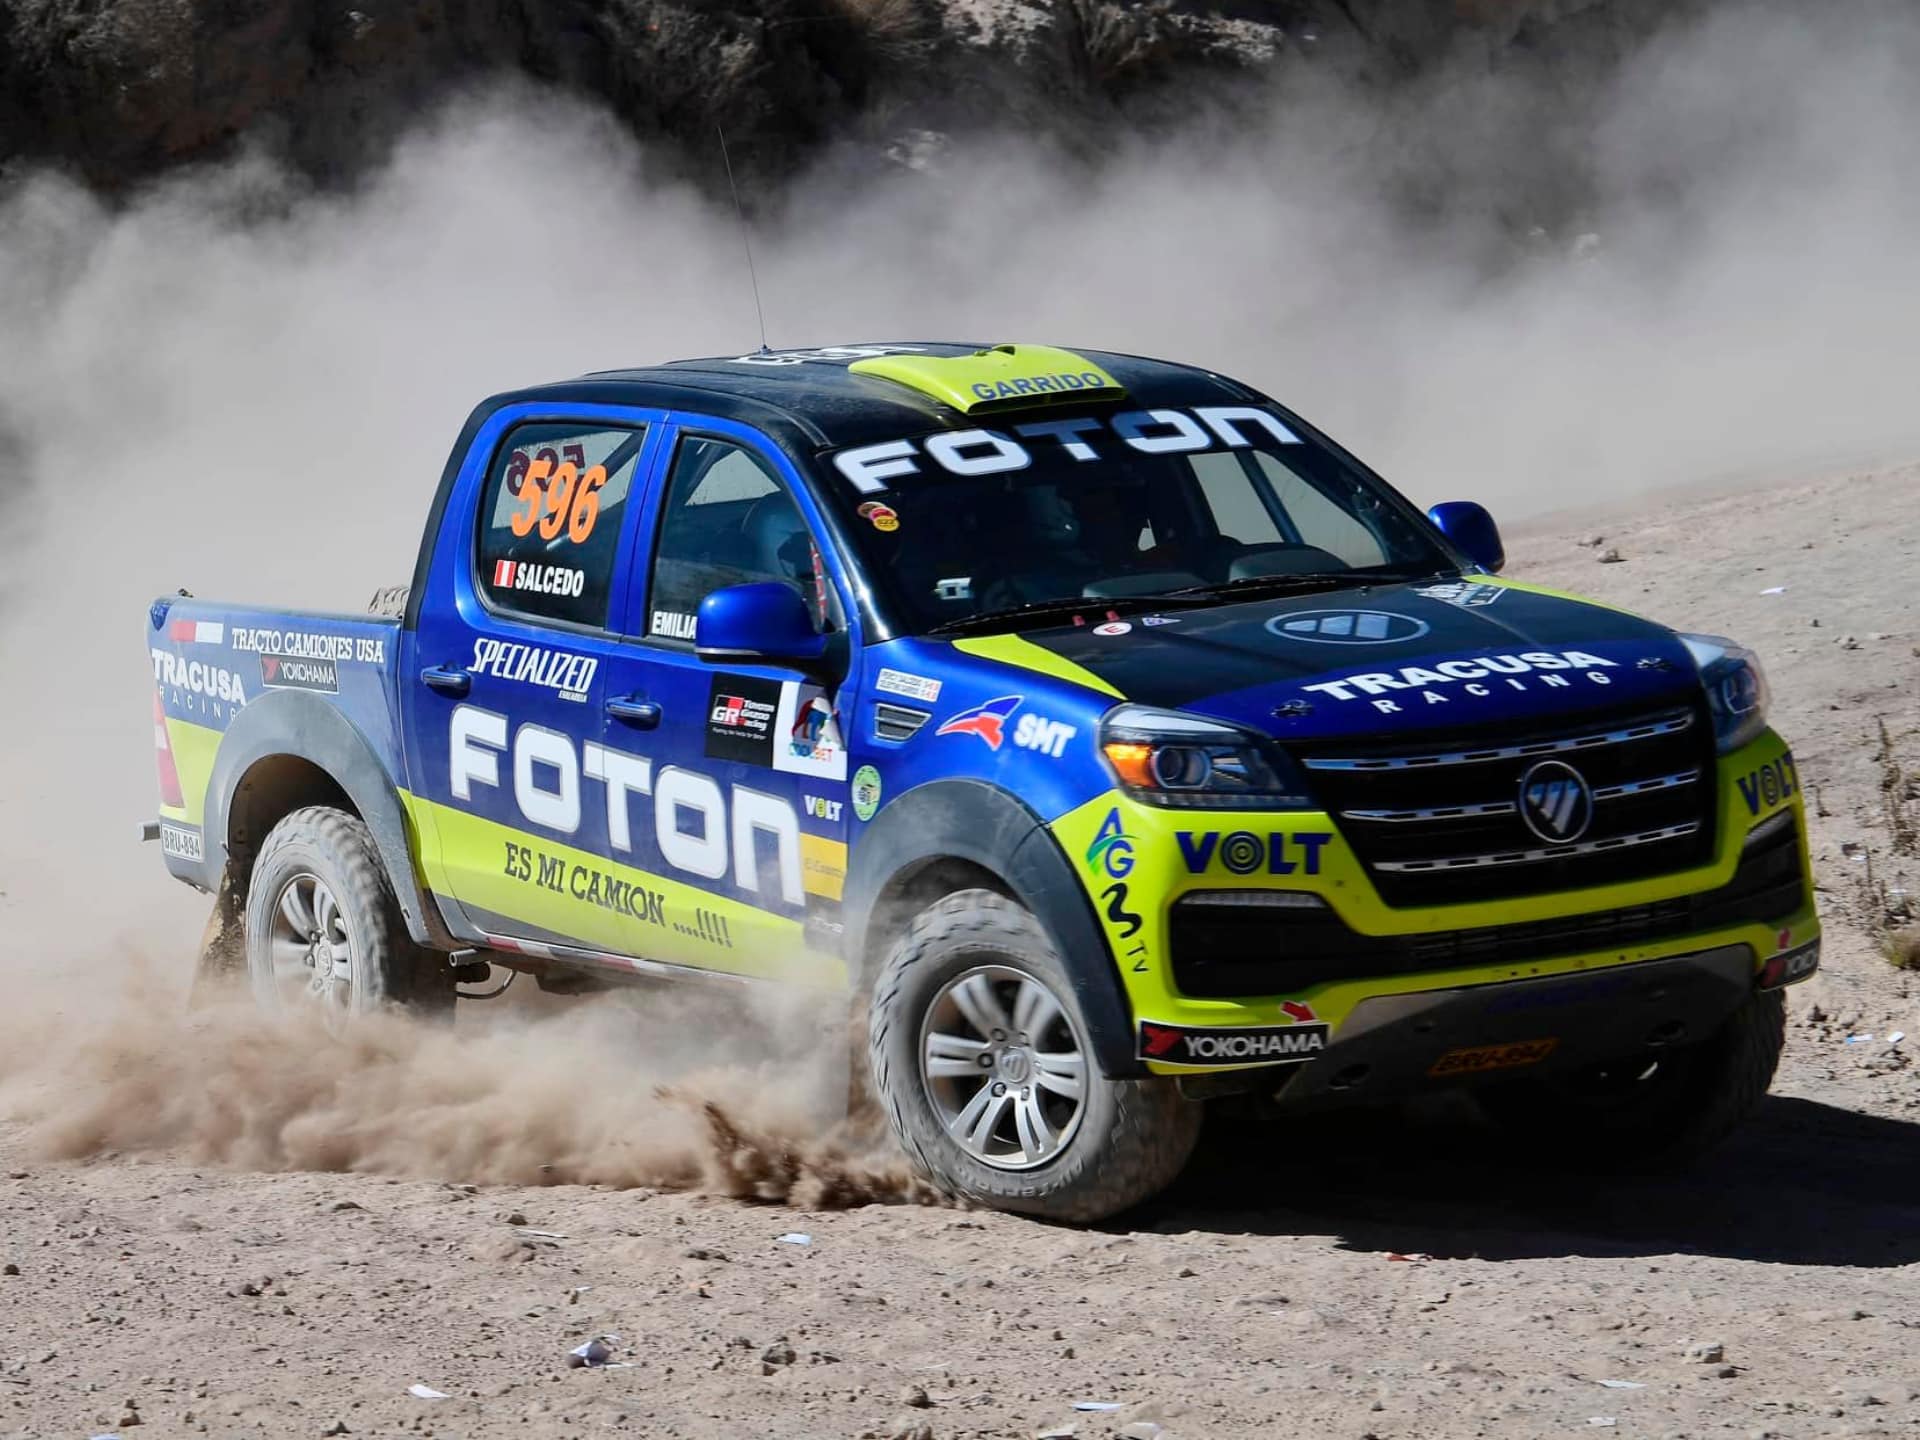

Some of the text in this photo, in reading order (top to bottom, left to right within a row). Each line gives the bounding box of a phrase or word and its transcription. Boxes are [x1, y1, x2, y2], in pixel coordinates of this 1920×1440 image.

[971, 372, 1105, 400] GARRIDO
[833, 407, 1304, 495] FOTON
[511, 459, 608, 544] 596
[514, 561, 585, 598] SALCEDO
[231, 627, 385, 664] TRACTO CAMIONES USA
[466, 637, 598, 693] SPECIALIZED
[151, 647, 247, 706] TRACUSA
[279, 661, 337, 686] YOKOHAMA
[1301, 651, 1620, 701] TRACUSA
[1371, 671, 1611, 714] RACING
[711, 706, 740, 724] GR
[1013, 713, 1078, 758] SMT
[448, 702, 807, 907] FOTON
[1736, 751, 1799, 816] VOLT
[804, 795, 843, 822] VOLT
[1175, 831, 1334, 875] VOLT
[504, 841, 532, 882] ES
[536, 853, 567, 894] MI
[570, 865, 666, 928] CAMION
[1183, 1033, 1325, 1058] YOKOHAMA
